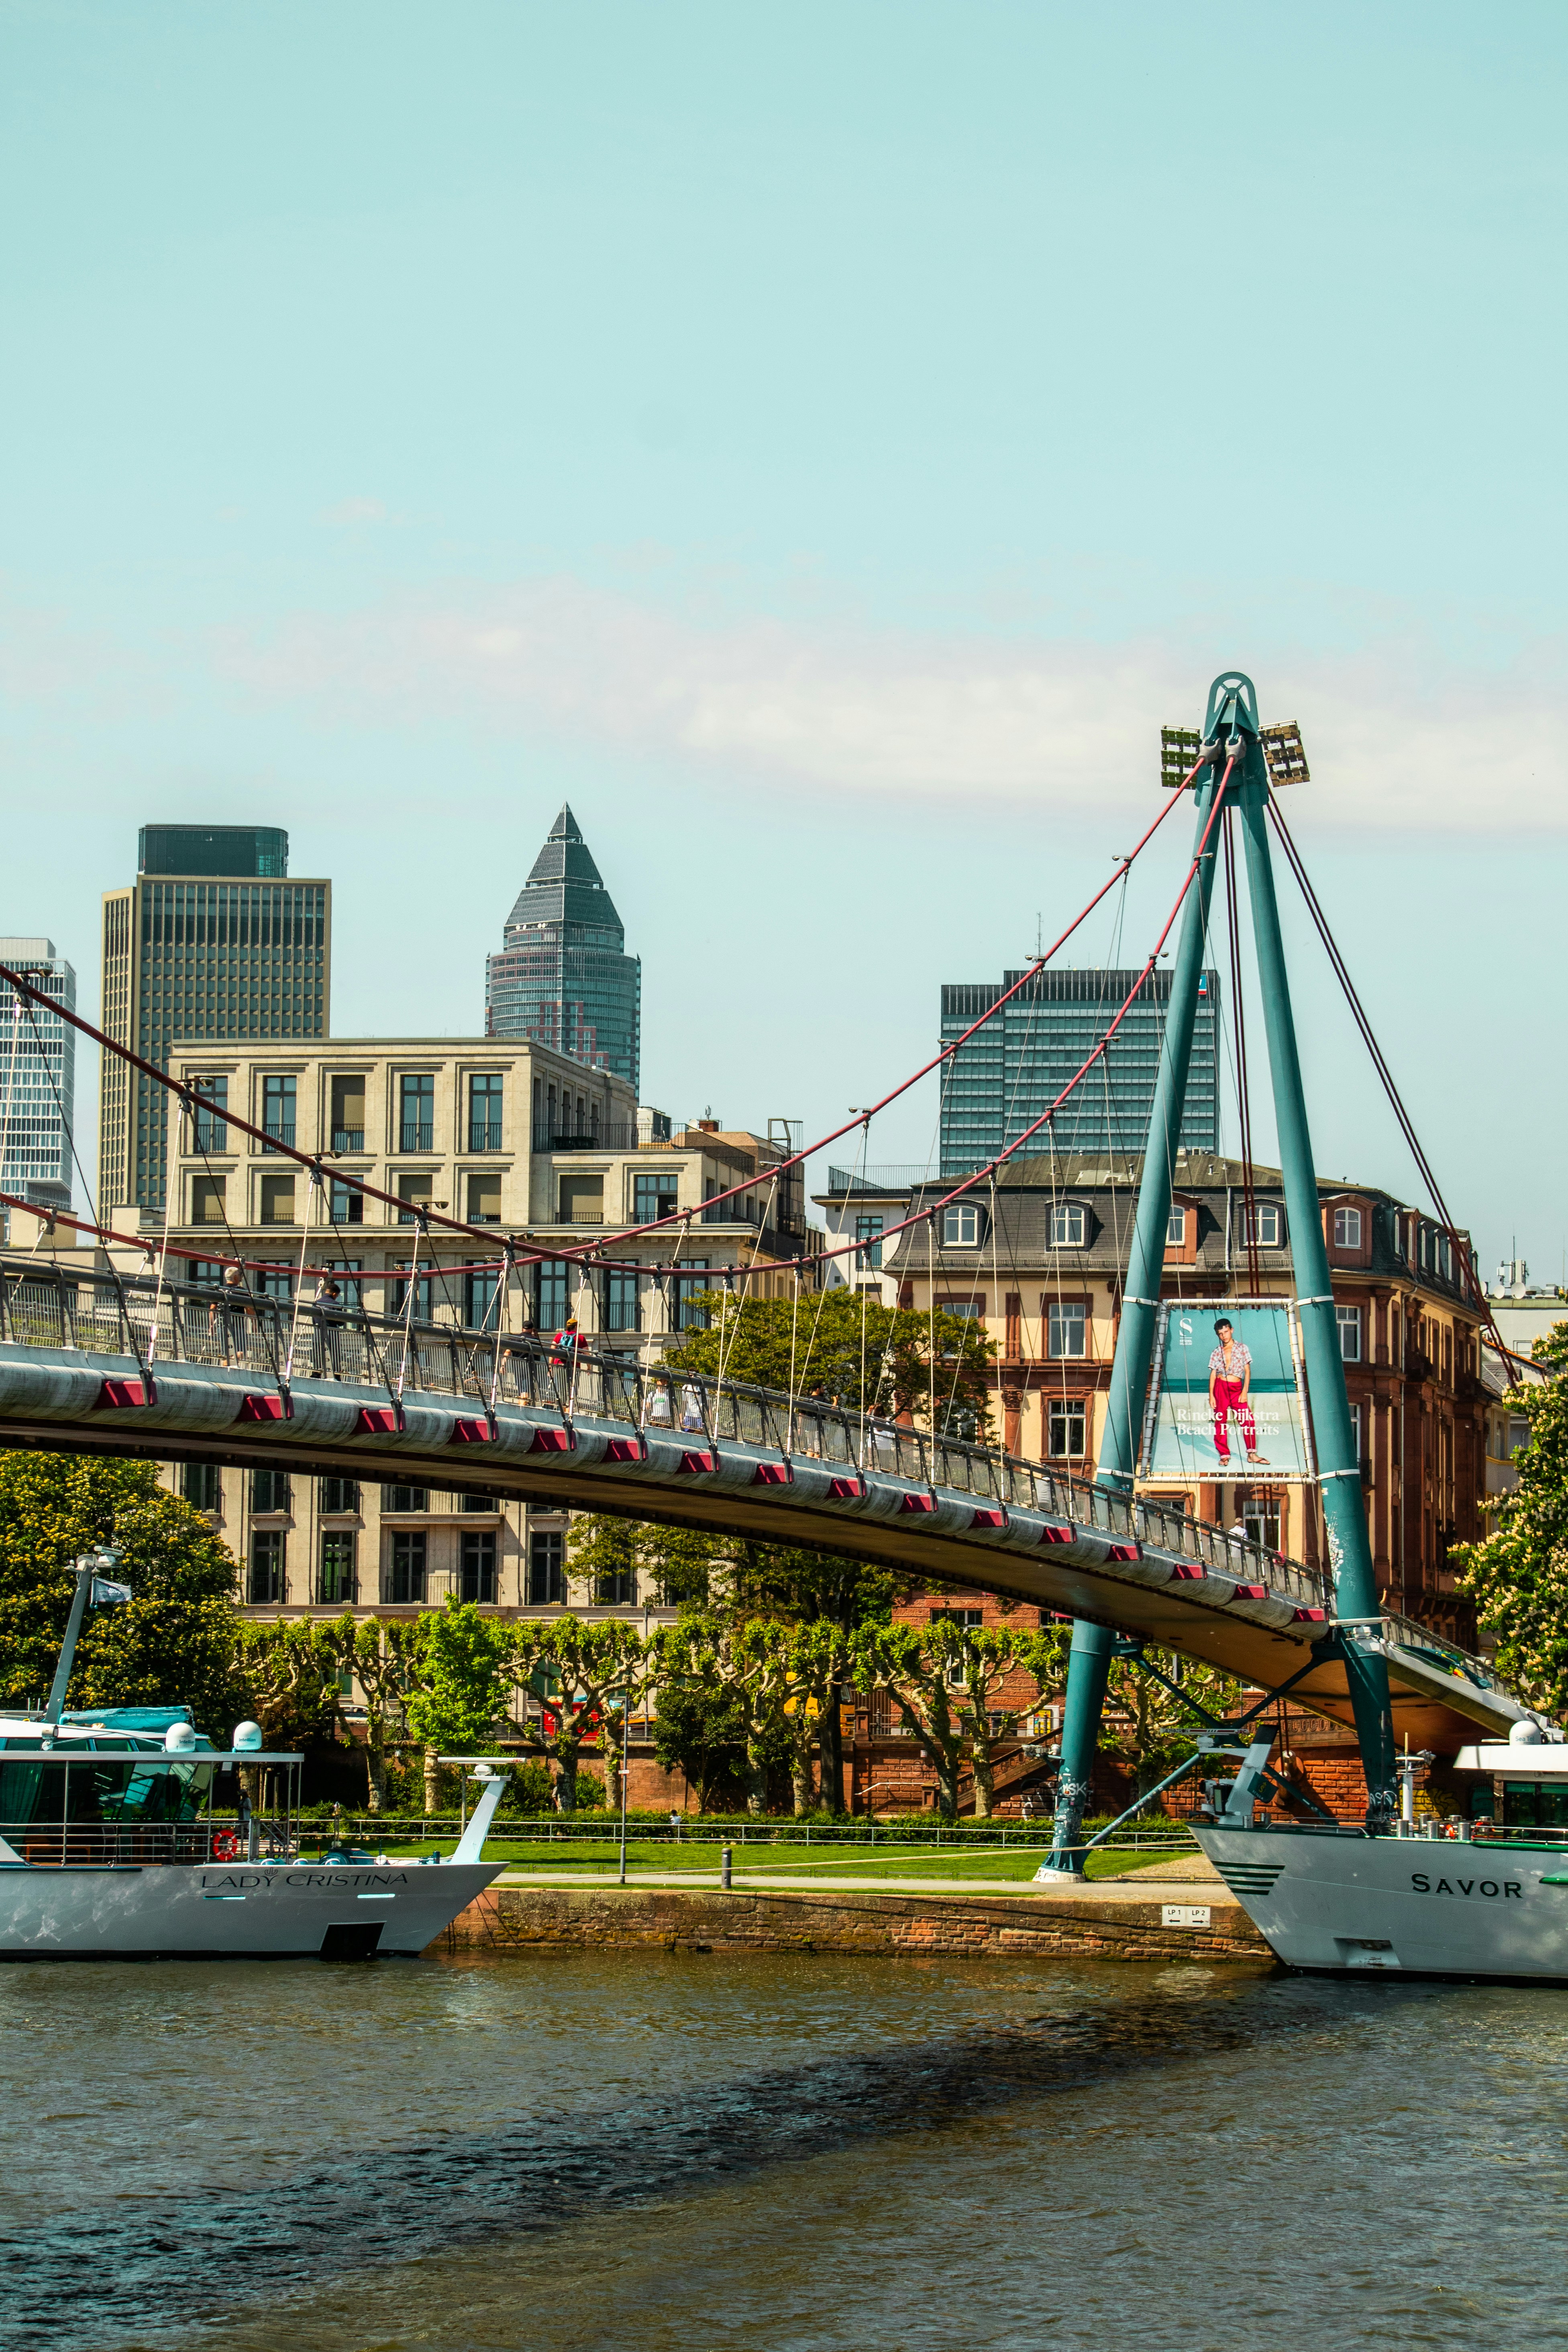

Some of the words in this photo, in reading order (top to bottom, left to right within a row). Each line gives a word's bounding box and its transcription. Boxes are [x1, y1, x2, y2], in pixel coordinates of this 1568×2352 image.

[1177, 1408, 1223, 1421] Rineke
[1226, 1409, 1279, 1425] Dijkstra
[1177, 1423, 1217, 1435] Beach
[1219, 1423, 1279, 1435] Portraits
[202, 1875, 278, 1888] LADY
[285, 1873, 408, 1887] CRISTINA
[1411, 1872, 1523, 1898] SAVOR
